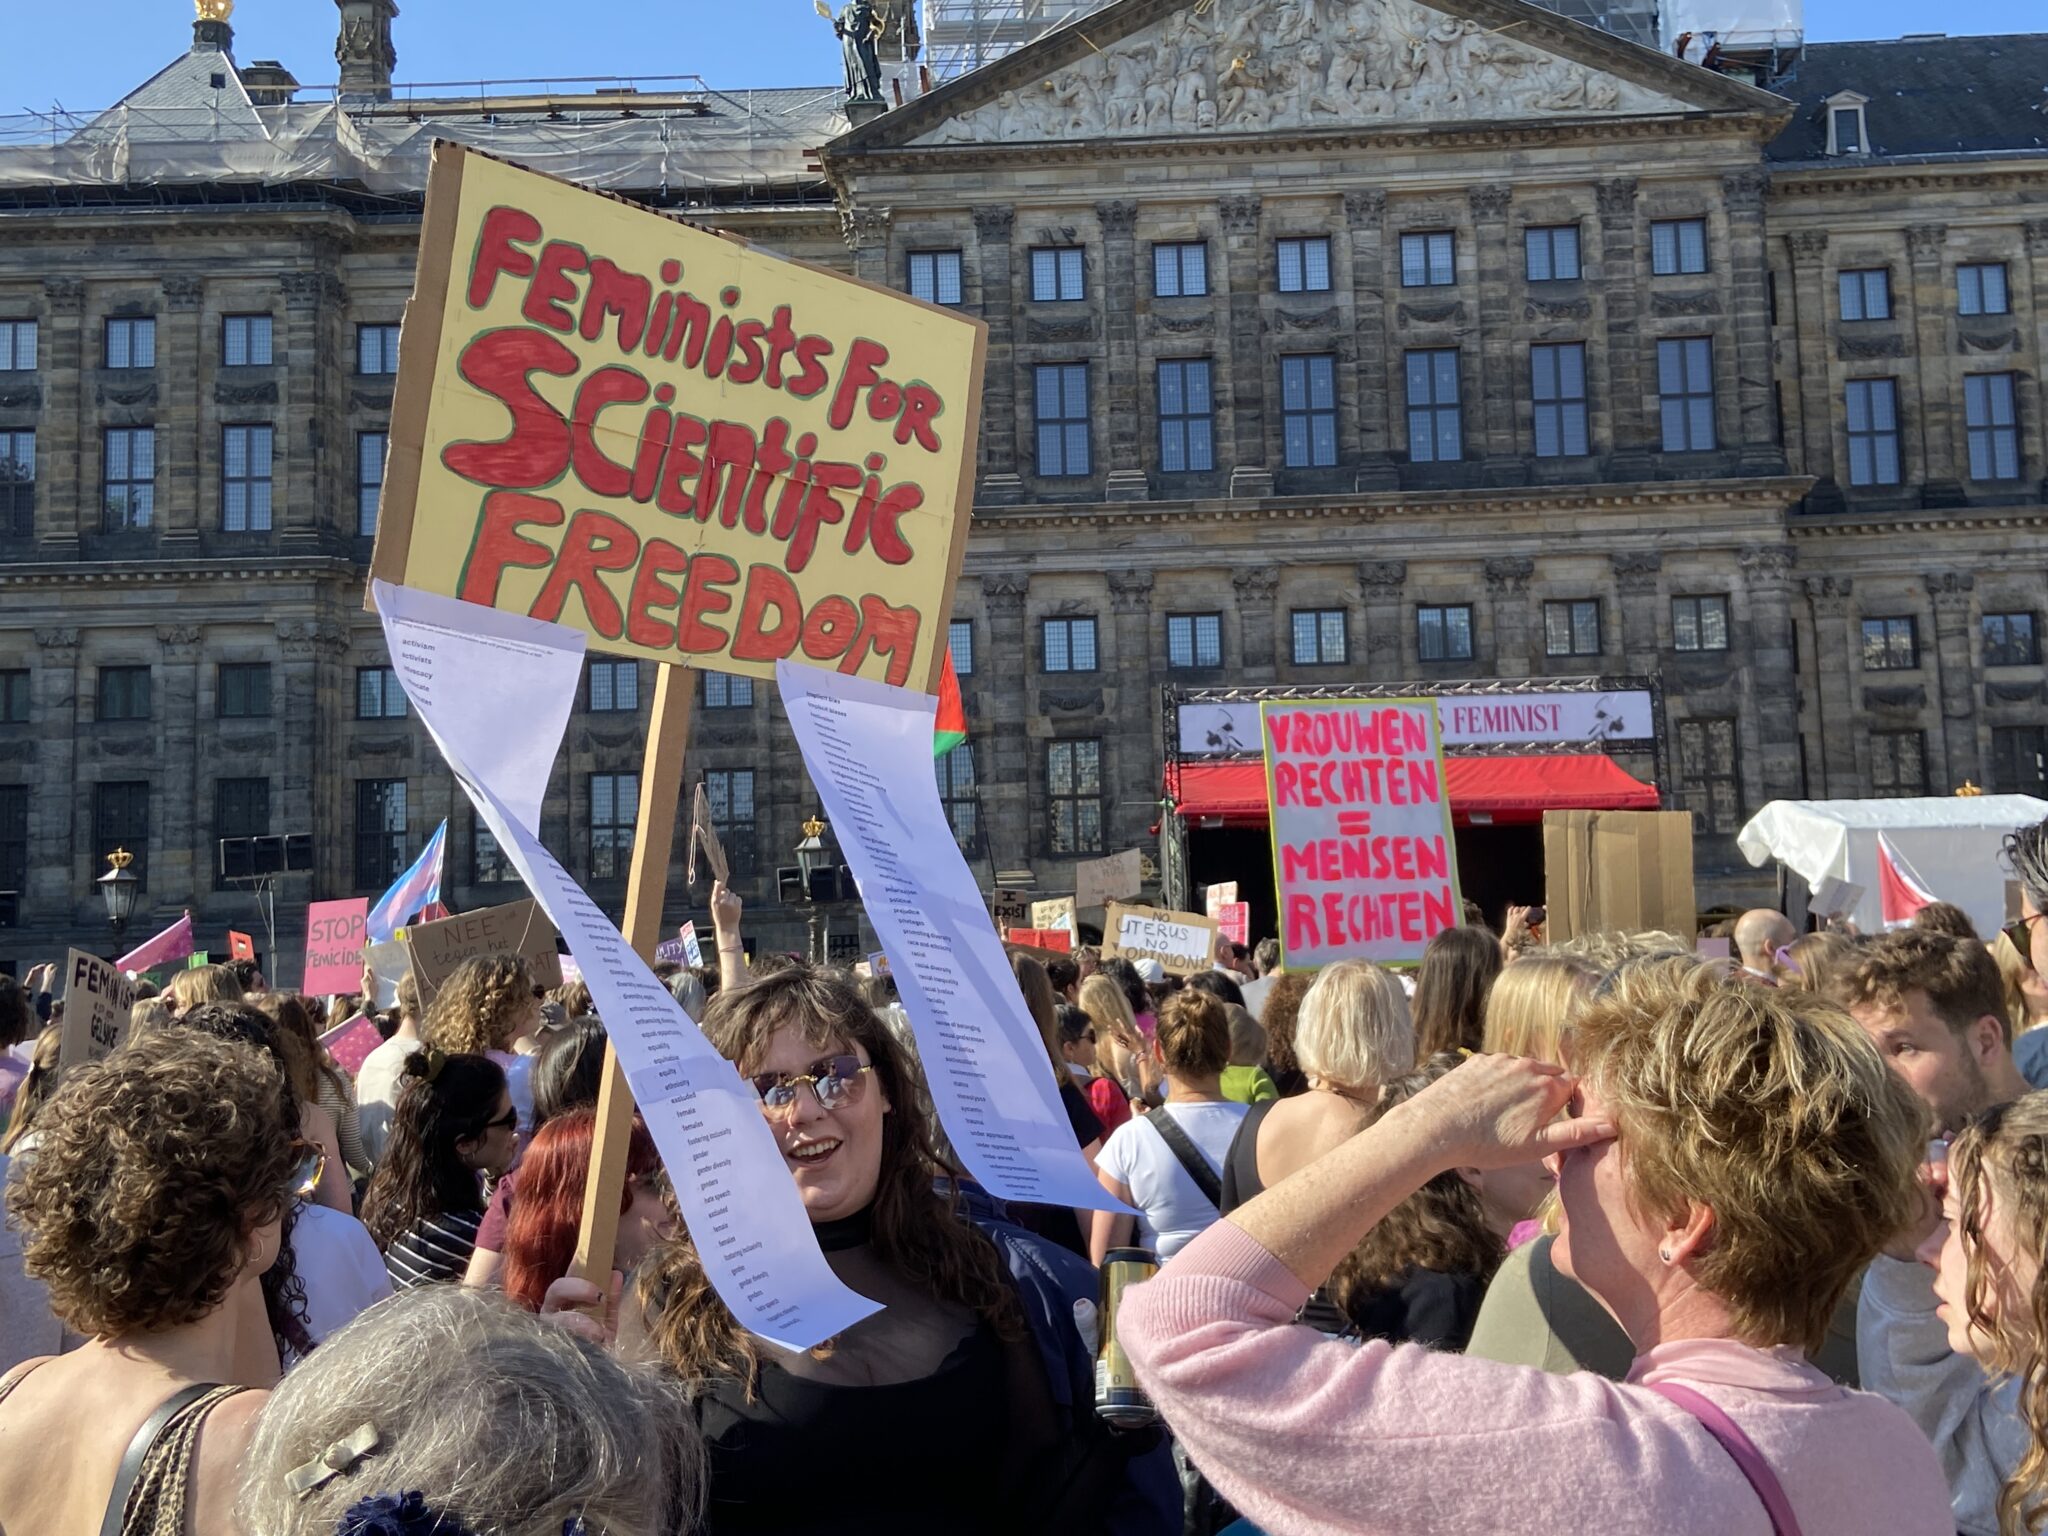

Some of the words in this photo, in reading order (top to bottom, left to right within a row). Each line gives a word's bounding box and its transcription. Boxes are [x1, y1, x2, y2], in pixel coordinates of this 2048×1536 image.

[457, 488, 921, 688] FREEDOM
[402, 638, 435, 652] activism
[402, 652, 432, 665] activists
[828, 695, 841, 704] bias
[829, 706, 847, 717] biases
[1455, 704, 1562, 735] FEMINIST
[1267, 708, 1428, 757] VROUWEN
[1275, 758, 1440, 807] RECHTEN
[1337, 811, 1371, 836] =
[1282, 835, 1449, 883] MENSEN
[1002, 890, 1017, 902] I
[893, 908, 920, 916] prejudice
[994, 903, 1027, 920] EXIST
[1152, 911, 1170, 923] NO
[1287, 885, 1456, 951] RECHTEN
[310, 914, 365, 943] STOP
[443, 914, 497, 947] NEE
[1116, 918, 1189, 941] UTERUS
[903, 928, 931, 939] promoting
[930, 934, 952, 943] diversity
[488, 937, 509, 953] het
[1145, 938, 1169, 950] NO
[930, 965, 952, 975] diversity
[648, 1042, 671, 1051] equality
[659, 1068, 677, 1077] equity
[665, 1079, 690, 1091] ethnicity
[671, 1092, 697, 1104] excluded
[682, 1120, 704, 1131] females
[687, 1134, 710, 1145] fostering
[693, 1151, 709, 1161] gender
